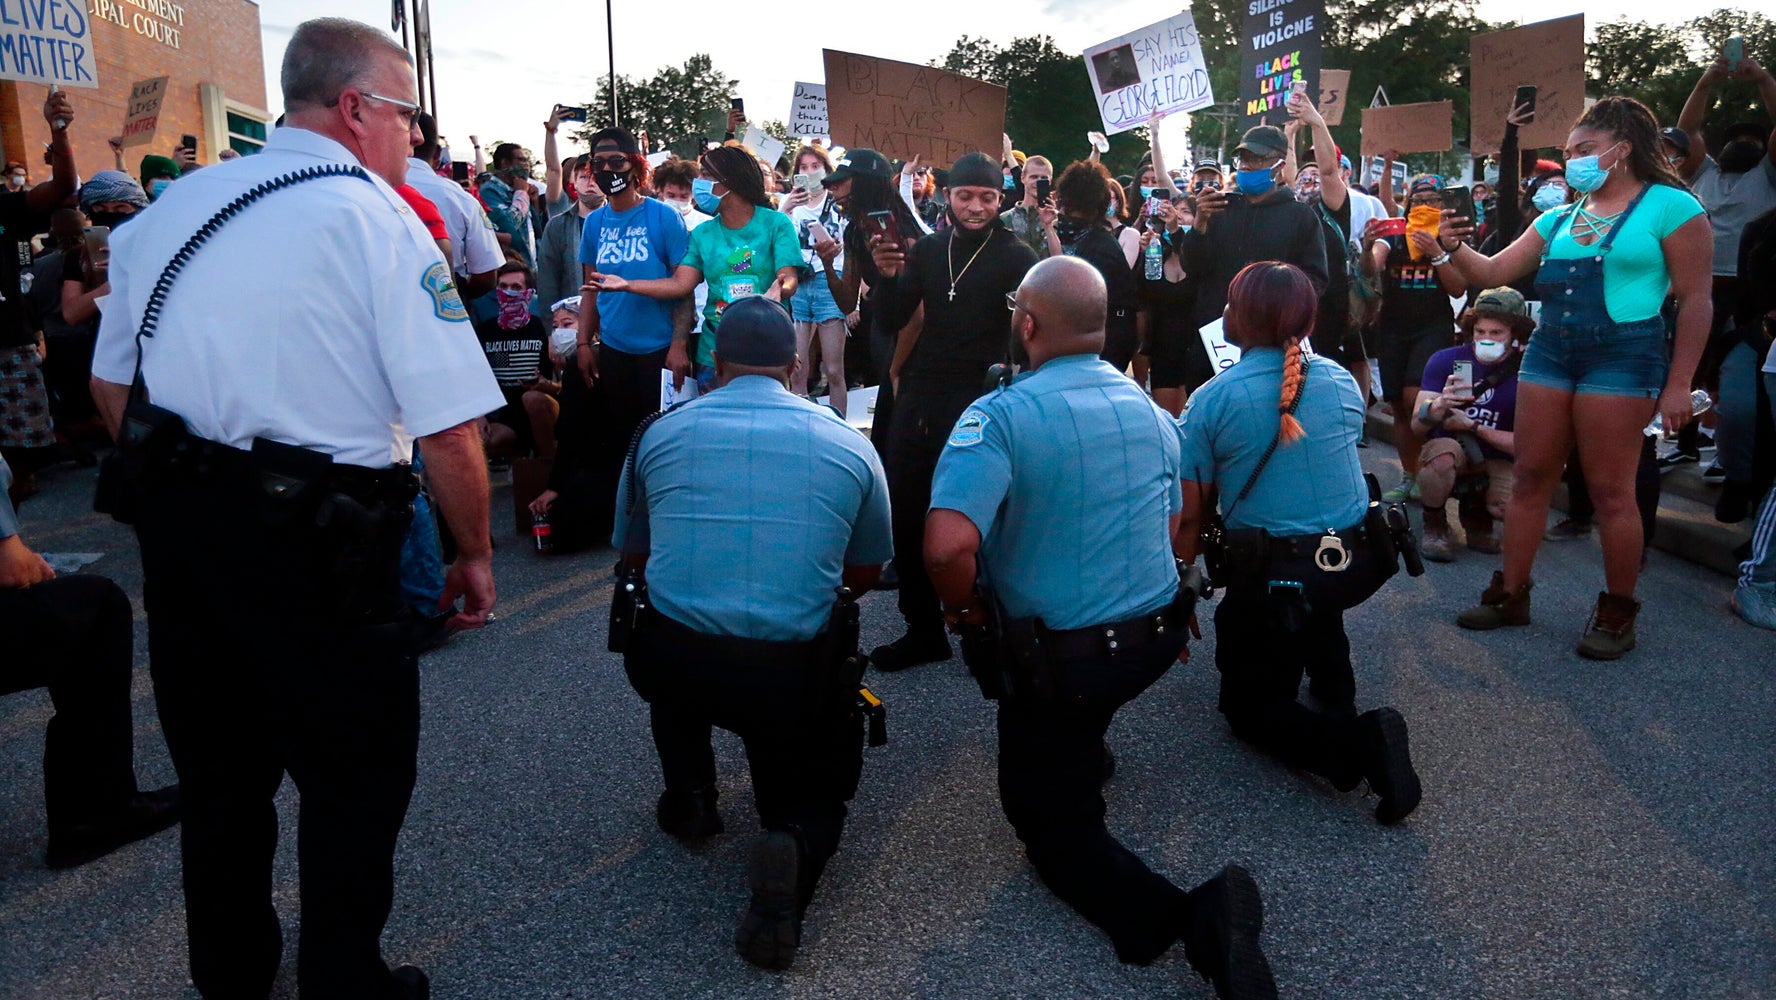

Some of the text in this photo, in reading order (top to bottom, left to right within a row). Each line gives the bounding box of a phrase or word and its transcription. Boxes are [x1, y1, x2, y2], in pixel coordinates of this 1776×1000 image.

[89, 0, 180, 49] IPAL COURT
[1252, 15, 1314, 50] VIOLCNE
[1269, 10, 1284, 28] IS
[0, 33, 92, 82] MATTER
[1132, 24, 1197, 62] SAY HIS
[1255, 50, 1301, 79] BLACK
[843, 54, 982, 118] BLACK
[1102, 68, 1209, 124] GEORGE FLOYD
[1260, 69, 1302, 94] LIVES
[129, 98, 158, 117] LIVES
[798, 103, 817, 111] will
[870, 98, 945, 133] LIVES
[125, 115, 158, 137] MATTER
[596, 235, 649, 265] JESUS
[485, 339, 543, 353] BLACK LIVES MATTER
[1465, 406, 1500, 421] ORI
